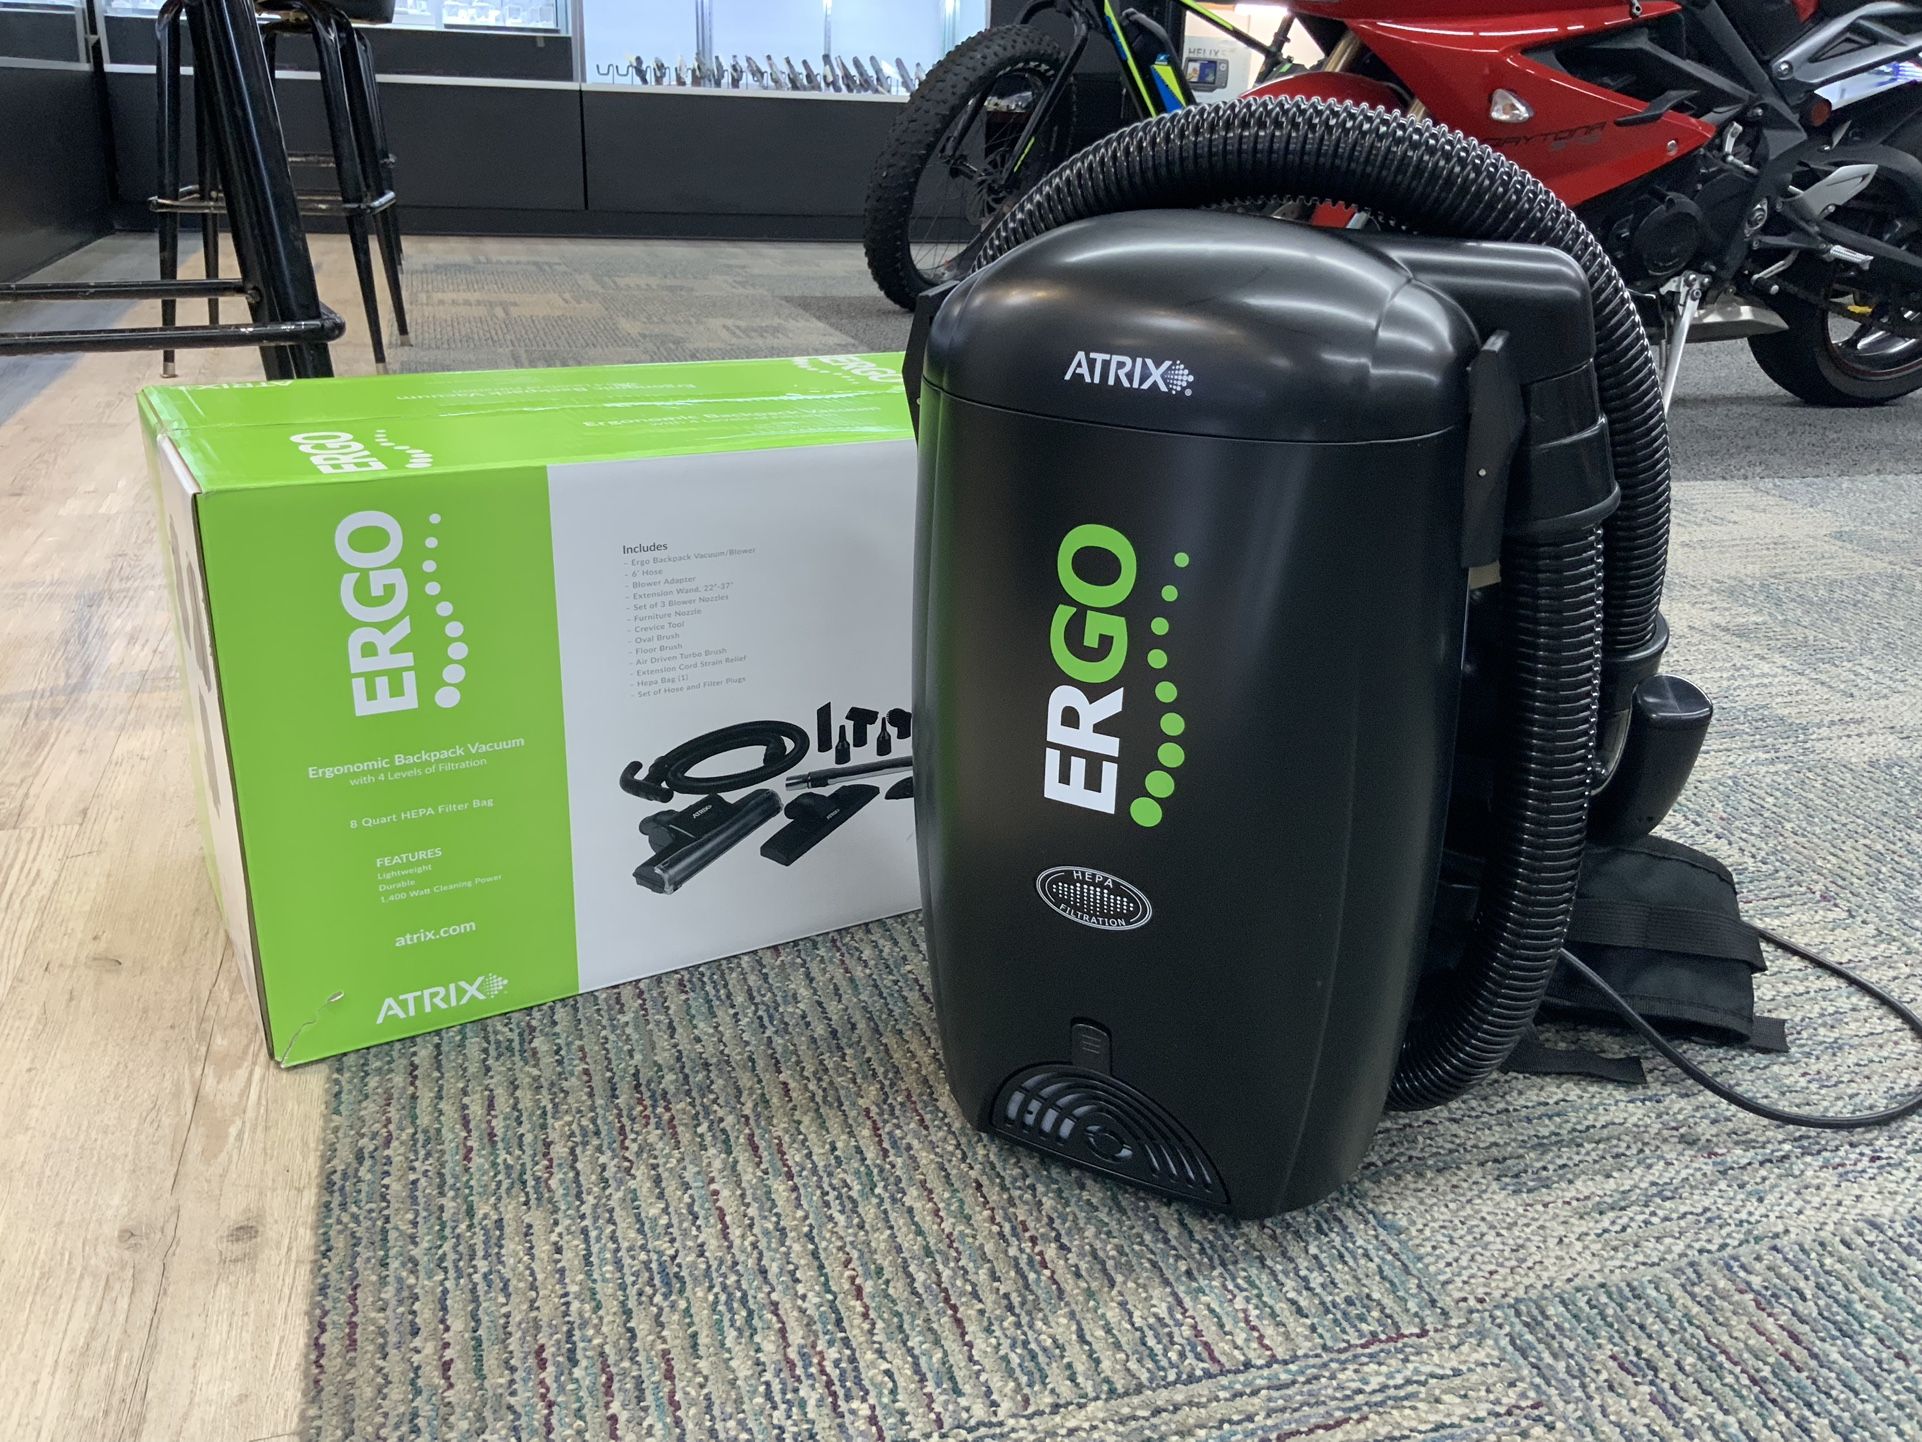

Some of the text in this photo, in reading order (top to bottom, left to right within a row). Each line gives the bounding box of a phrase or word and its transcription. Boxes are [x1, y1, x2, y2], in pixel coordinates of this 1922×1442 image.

[1064, 351, 1173, 392] ATRIX
[289, 431, 388, 474] ERGO
[622, 542, 668, 555] Includes
[631, 559, 650, 567] Ergo
[652, 553, 691, 564] Backpack
[632, 580, 661, 589] Blower
[633, 590, 673, 600] Extension
[633, 594, 729, 611] Set of 3 Blower Nozzles
[334, 510, 419, 717] ERGO
[634, 611, 672, 622] Furniture
[634, 621, 685, 633] Crevice Tool
[635, 632, 680, 644] Oval Brush
[635, 643, 683, 655] Floor Brush
[636, 648, 728, 666] Air Driven Turbo Brush
[636, 666, 677, 677] Extension
[678, 662, 698, 671] Cord
[700, 658, 723, 668] Strain
[1043, 523, 1137, 815] ERGO
[638, 690, 651, 698] Set
[664, 685, 684, 694] Hose
[686, 682, 701, 691] and
[307, 737, 525, 780] Ergonomic Backpack Vacuum
[349, 757, 488, 786] with 4 Levels of Filtration
[350, 798, 495, 829] 8 Quart HEPA Filter Bag
[376, 847, 443, 868] FEATURES
[377, 863, 433, 880] Lightweight
[1072, 870, 1114, 889] HEPA
[378, 879, 416, 892] Durable
[409, 887, 431, 898] Watt
[433, 880, 473, 894] Cleaning
[474, 874, 503, 885] Power
[1059, 903, 1127, 927] FILTRATION
[395, 921, 477, 948] atrix.com
[376, 975, 488, 1025] ATRIX
